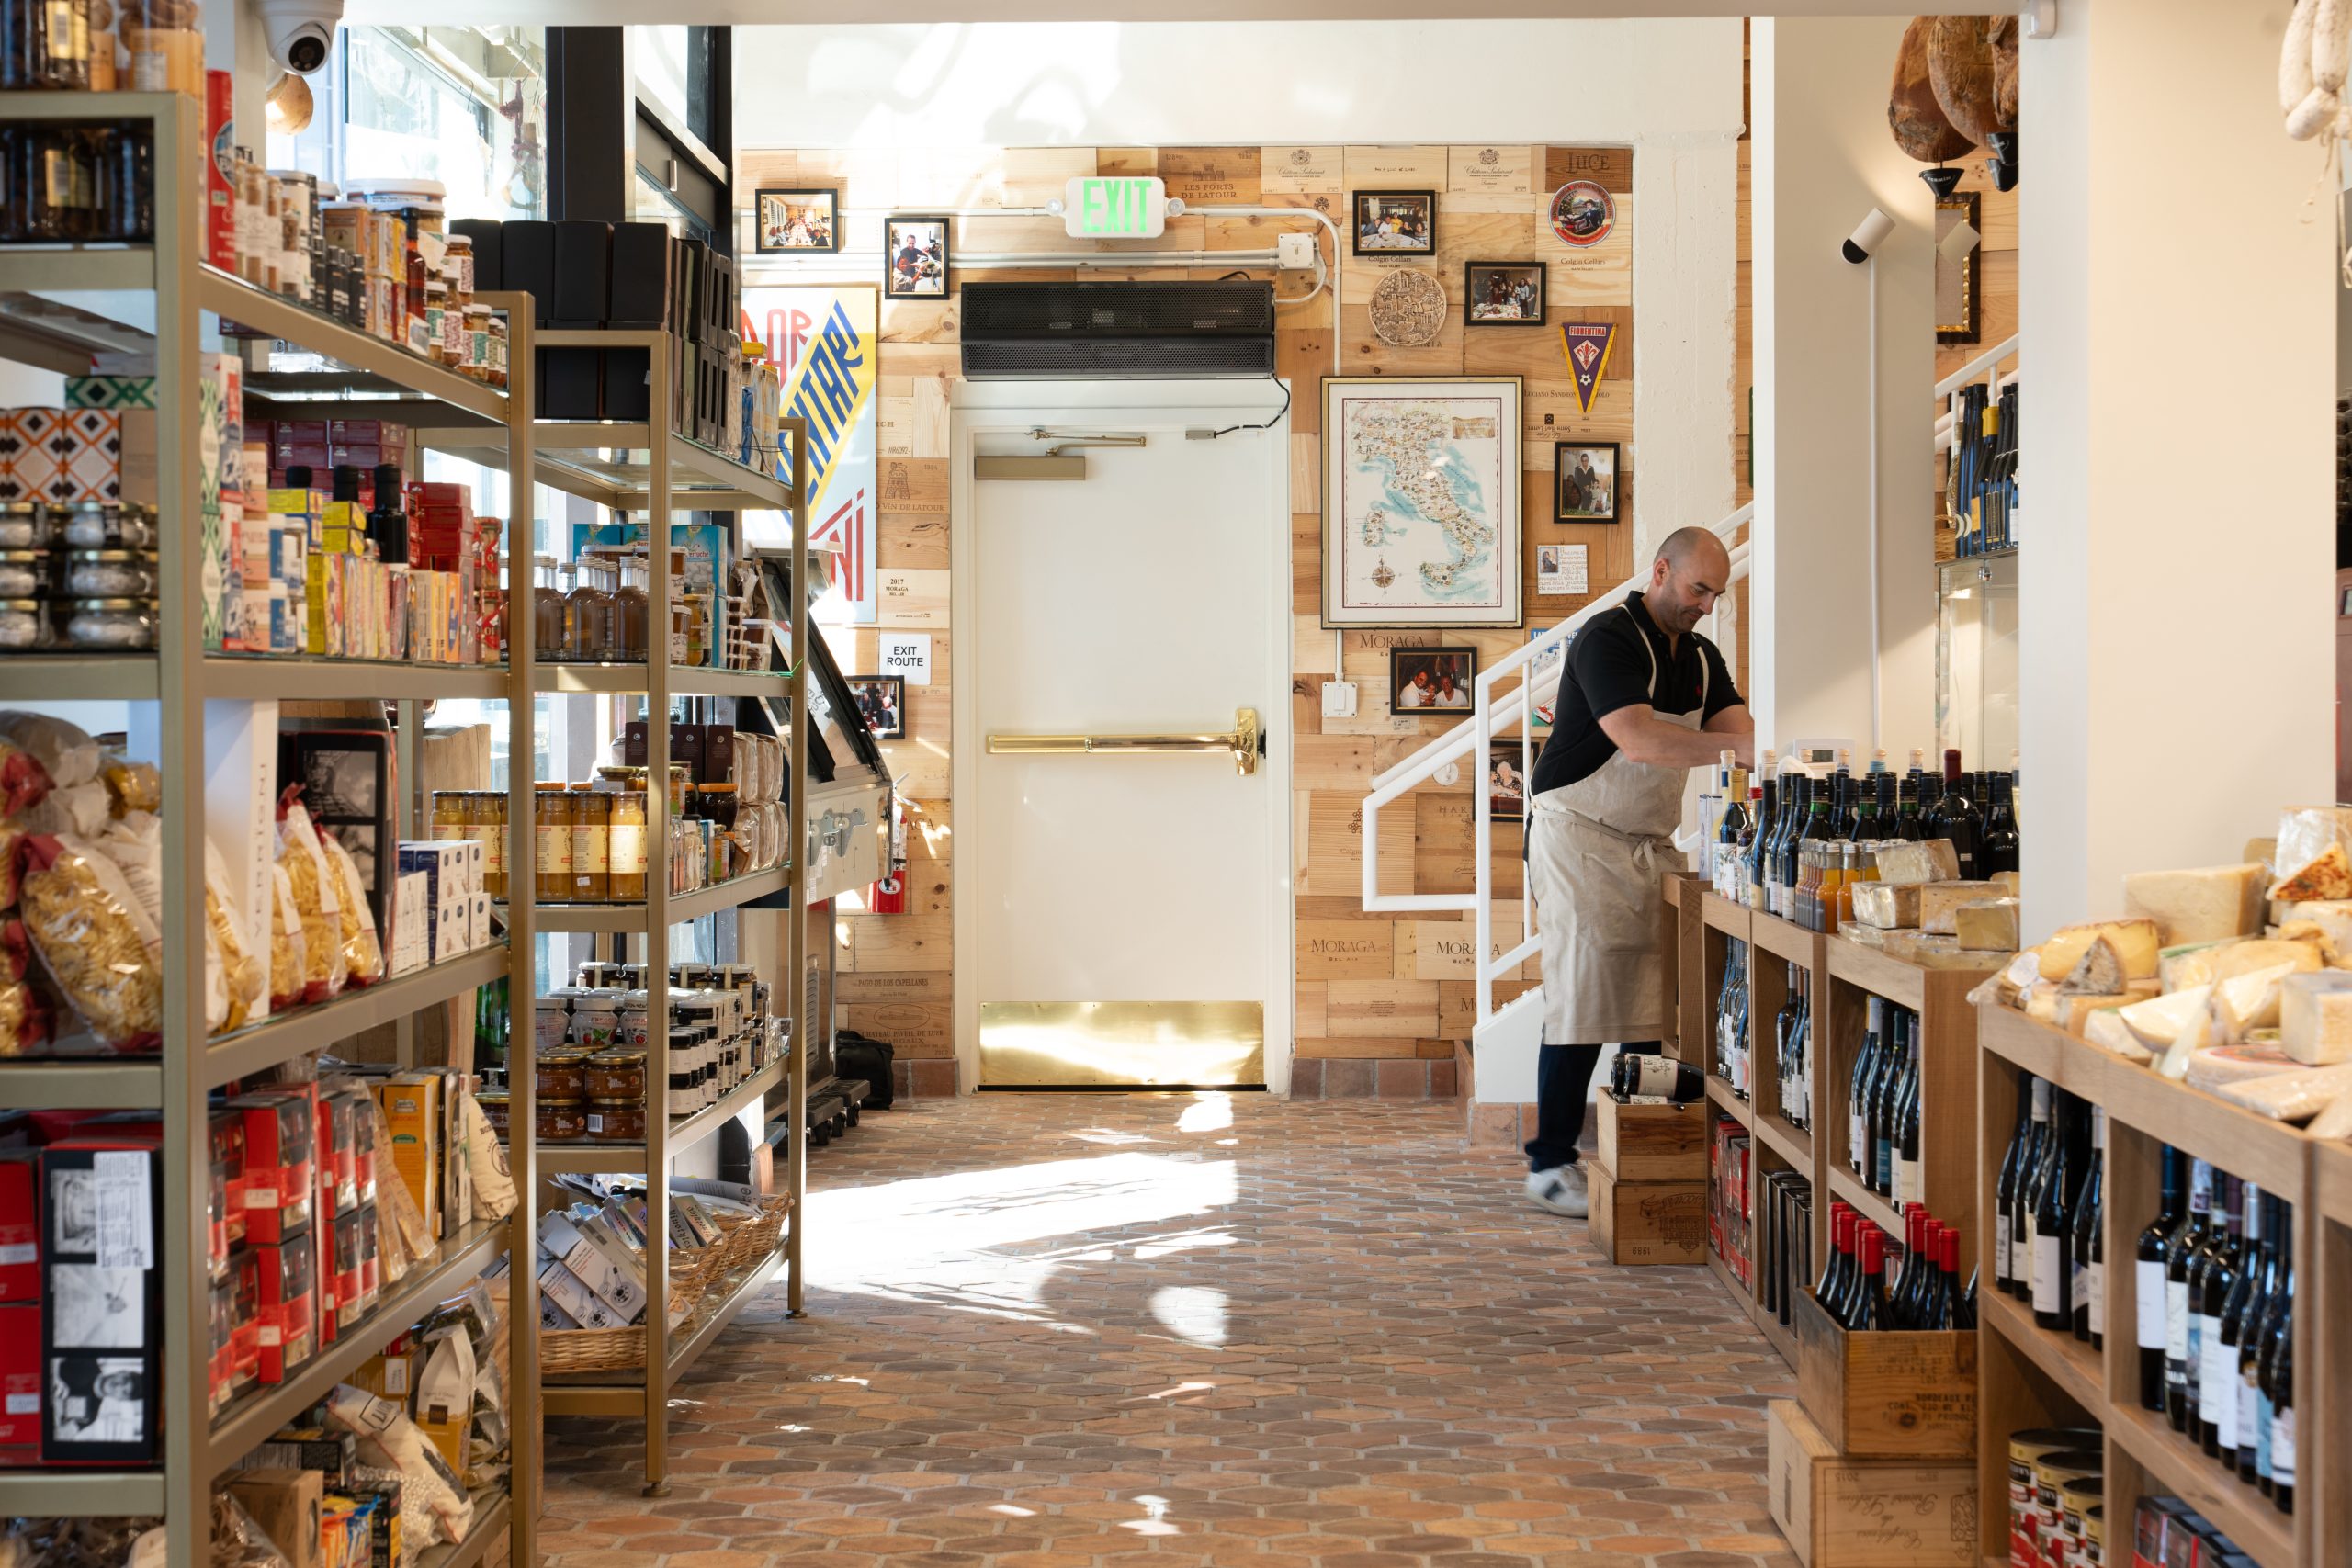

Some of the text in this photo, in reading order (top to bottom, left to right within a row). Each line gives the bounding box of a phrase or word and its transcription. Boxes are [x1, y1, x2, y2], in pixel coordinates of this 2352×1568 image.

[1198, 191, 1238, 199] LATOUR
[1083, 180, 1152, 233] EXIT
[1569, 326, 1606, 336] FIORENTINA
[1360, 634, 1425, 648] MORAGA
[893, 646, 917, 656] EXIT
[887, 657, 923, 667] ROUTE
[1311, 939, 1376, 953] MORAGA
[1436, 941, 1501, 956] MORAA
